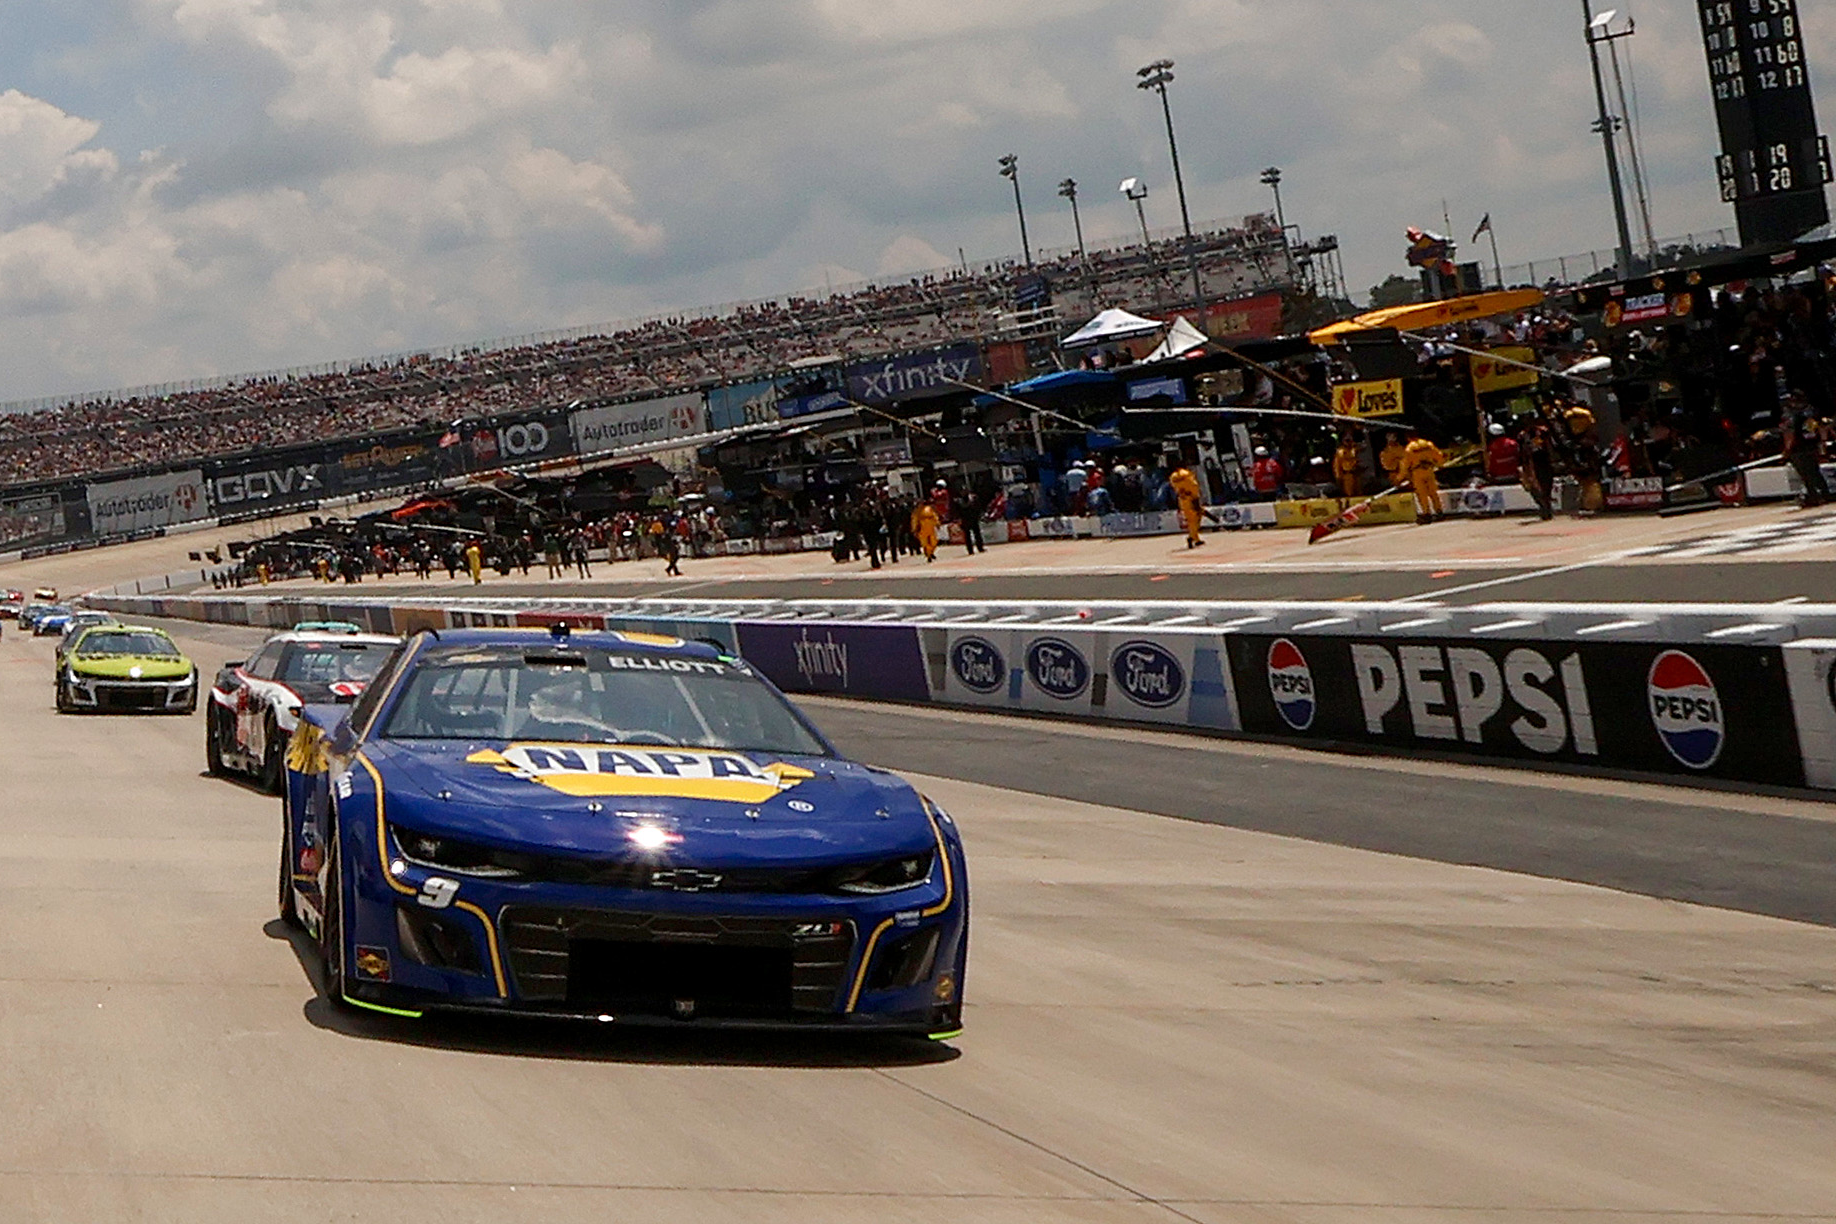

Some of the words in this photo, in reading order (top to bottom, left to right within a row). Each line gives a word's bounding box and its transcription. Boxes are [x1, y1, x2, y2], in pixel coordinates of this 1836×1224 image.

[1749, 21, 1769, 40] 10
[1754, 46, 1772, 64] 11
[1776, 40, 1798, 64] 60
[1758, 71, 1778, 89] 12
[1785, 66, 1802, 87] 17
[1770, 143, 1788, 165] 19
[1769, 166, 1791, 191] 20
[863, 357, 970, 398] xfinity
[584, 415, 664, 440] Autotrader
[217, 464, 323, 503] GOVX
[608, 656, 726, 675] ELLIOTT
[793, 627, 848, 688] xfinity
[963, 645, 995, 683] Ford
[1038, 647, 1076, 689] Ford
[1126, 651, 1170, 697] Ford
[1272, 673, 1311, 696] PEPSI
[1351, 644, 1598, 756] PEPSI
[1655, 694, 1717, 723] PEPSI
[523, 748, 769, 782] NAPA
[417, 876, 460, 908] 9
